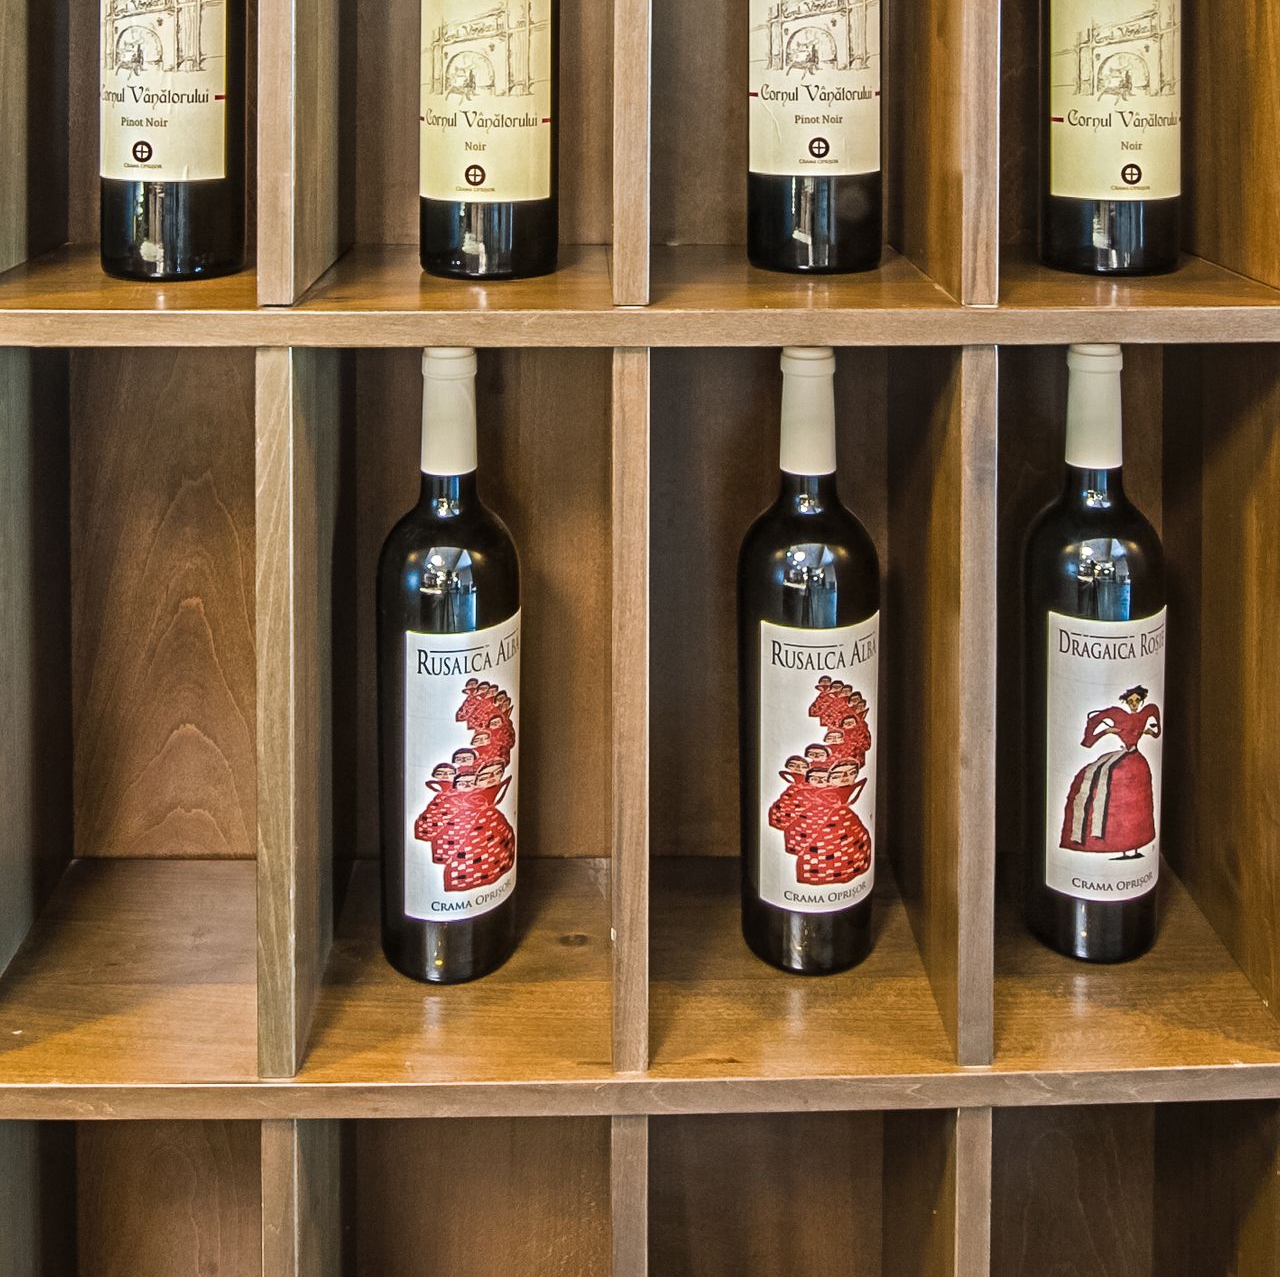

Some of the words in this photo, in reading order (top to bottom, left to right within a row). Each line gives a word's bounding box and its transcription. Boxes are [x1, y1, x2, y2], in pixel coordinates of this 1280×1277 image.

[127, 84, 209, 110] Vânătorului
[761, 83, 798, 107] Cornul
[801, 84, 872, 107] Vânătorului
[121, 117, 143, 127] Pinot
[145, 117, 168, 128] Noir
[426, 108, 457, 133] Cornul
[461, 110, 538, 134] Vânătorului
[795, 115, 821, 124] Pinot
[822, 115, 843, 124] Noir
[1067, 109, 1112, 133] Cornul
[465, 141, 487, 151] Noir
[1121, 141, 1143, 150] Noir
[1072, 877, 1113, 892] CRAMA
[783, 890, 825, 904] CRAMA
[431, 900, 472, 912] CRAMA
